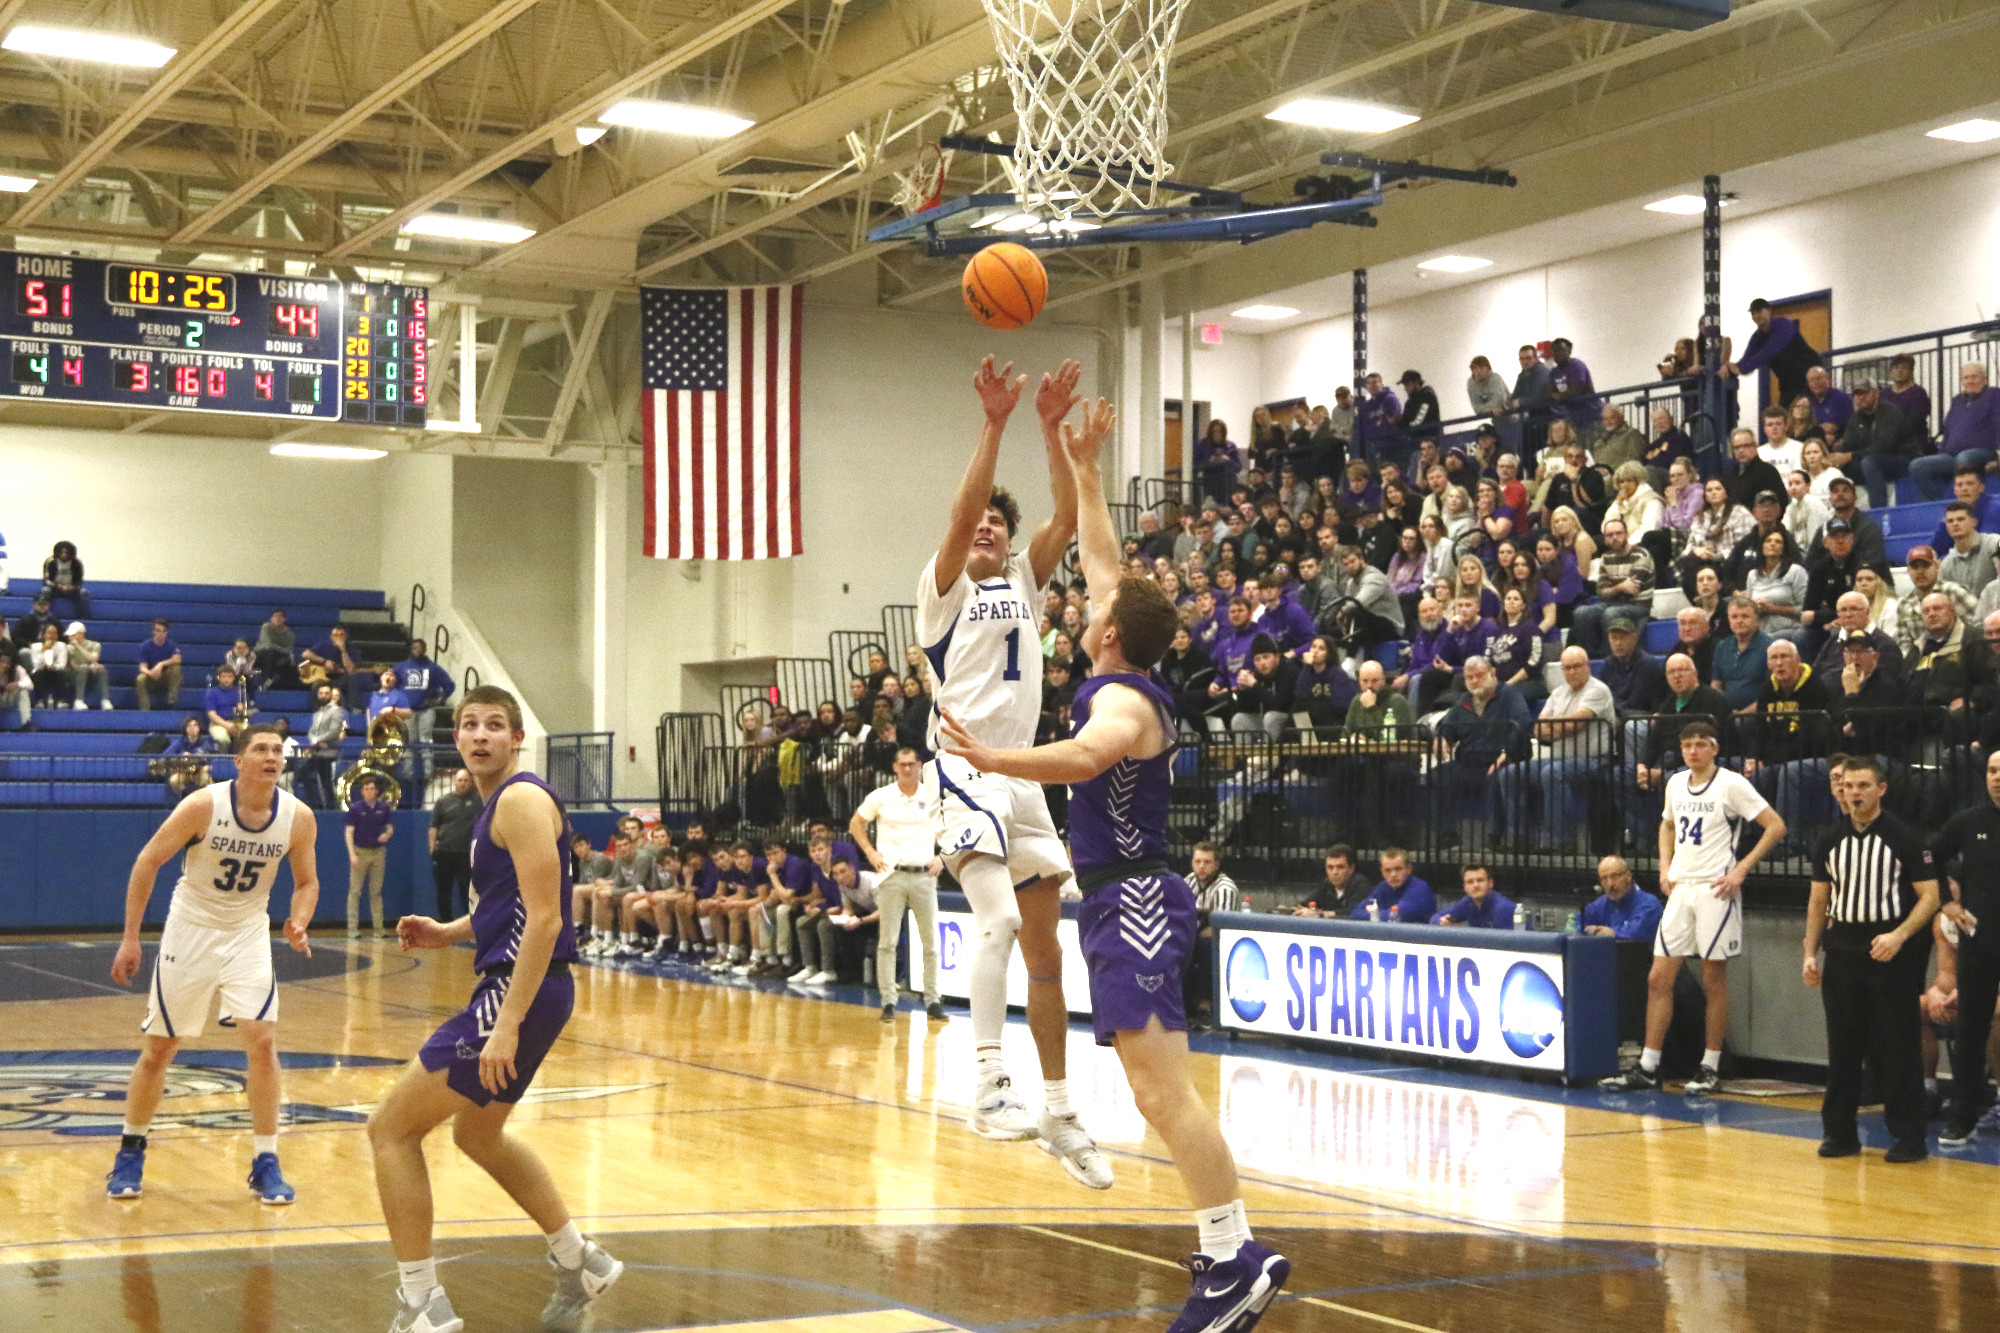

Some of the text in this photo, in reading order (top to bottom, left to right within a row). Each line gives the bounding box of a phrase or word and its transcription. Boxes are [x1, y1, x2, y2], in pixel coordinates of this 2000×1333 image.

[17, 257, 72, 278] HOME
[26, 281, 71, 317] 51
[130, 270, 226, 310] 10:25
[259, 278, 328, 301] VISITOR
[404, 287, 424, 299] PTS
[112, 306, 136, 317] POSS
[364, 295, 370, 313] 1
[413, 299, 426, 318] 5
[33, 321, 73, 335] BONUS
[138, 322, 181, 337] PERIOD
[208, 314, 230, 325] POSS
[276, 304, 318, 338] 44
[358, 316, 370, 335] 3
[408, 320, 427, 340] 16
[185, 321, 203, 348] 2
[12, 341, 49, 354] FOULS
[62, 344, 84, 357] TOL
[110, 348, 243, 369] PLAYER POINTS FOULS
[265, 340, 303, 354] BONUS
[346, 337, 369, 356] 20
[413, 342, 426, 361] 5
[30, 357, 48, 383] 4
[64, 359, 82, 386] 4
[254, 359, 274, 372] TOL
[288, 361, 322, 375] FOULS
[346, 358, 369, 378] 23
[414, 363, 426, 382] 3
[20, 385, 45, 396] WON
[255, 373, 273, 400] 4
[313, 377, 320, 402] 1
[345, 380, 369, 400] 25
[413, 385, 426, 404] 5
[168, 395, 199, 407] GAME
[291, 403, 314, 414] WON
[969, 600, 1030, 622] SPARTA
[1003, 627, 1021, 681] 1
[1679, 816, 1703, 845] 34
[211, 836, 283, 857] SPARTANS
[213, 858, 267, 892] 35
[1286, 942, 1481, 1053] SPARTANS
